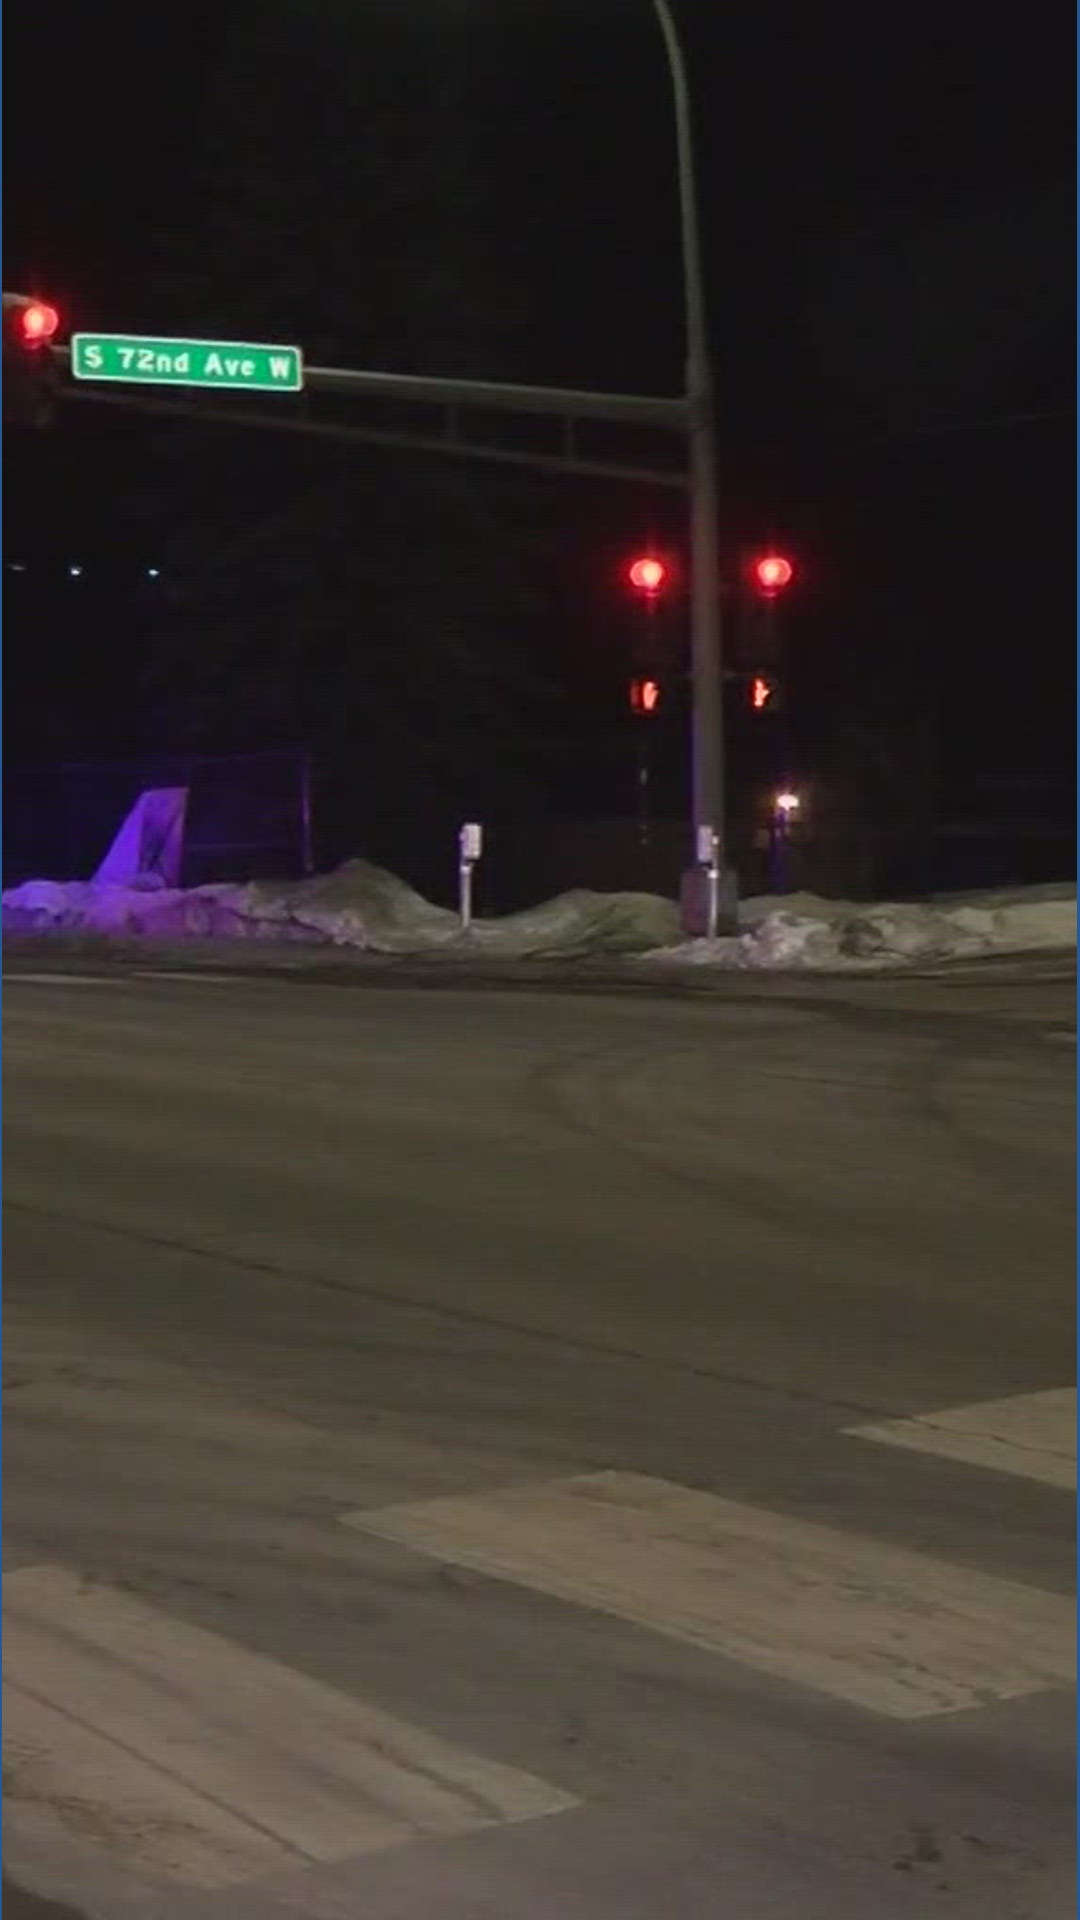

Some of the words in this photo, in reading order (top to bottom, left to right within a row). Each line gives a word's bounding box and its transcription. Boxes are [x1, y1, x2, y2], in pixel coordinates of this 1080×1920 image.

[85, 345, 103, 368] S
[117, 348, 190, 373] 72nd
[204, 353, 256, 376] Ave
[269, 356, 291, 379] W
